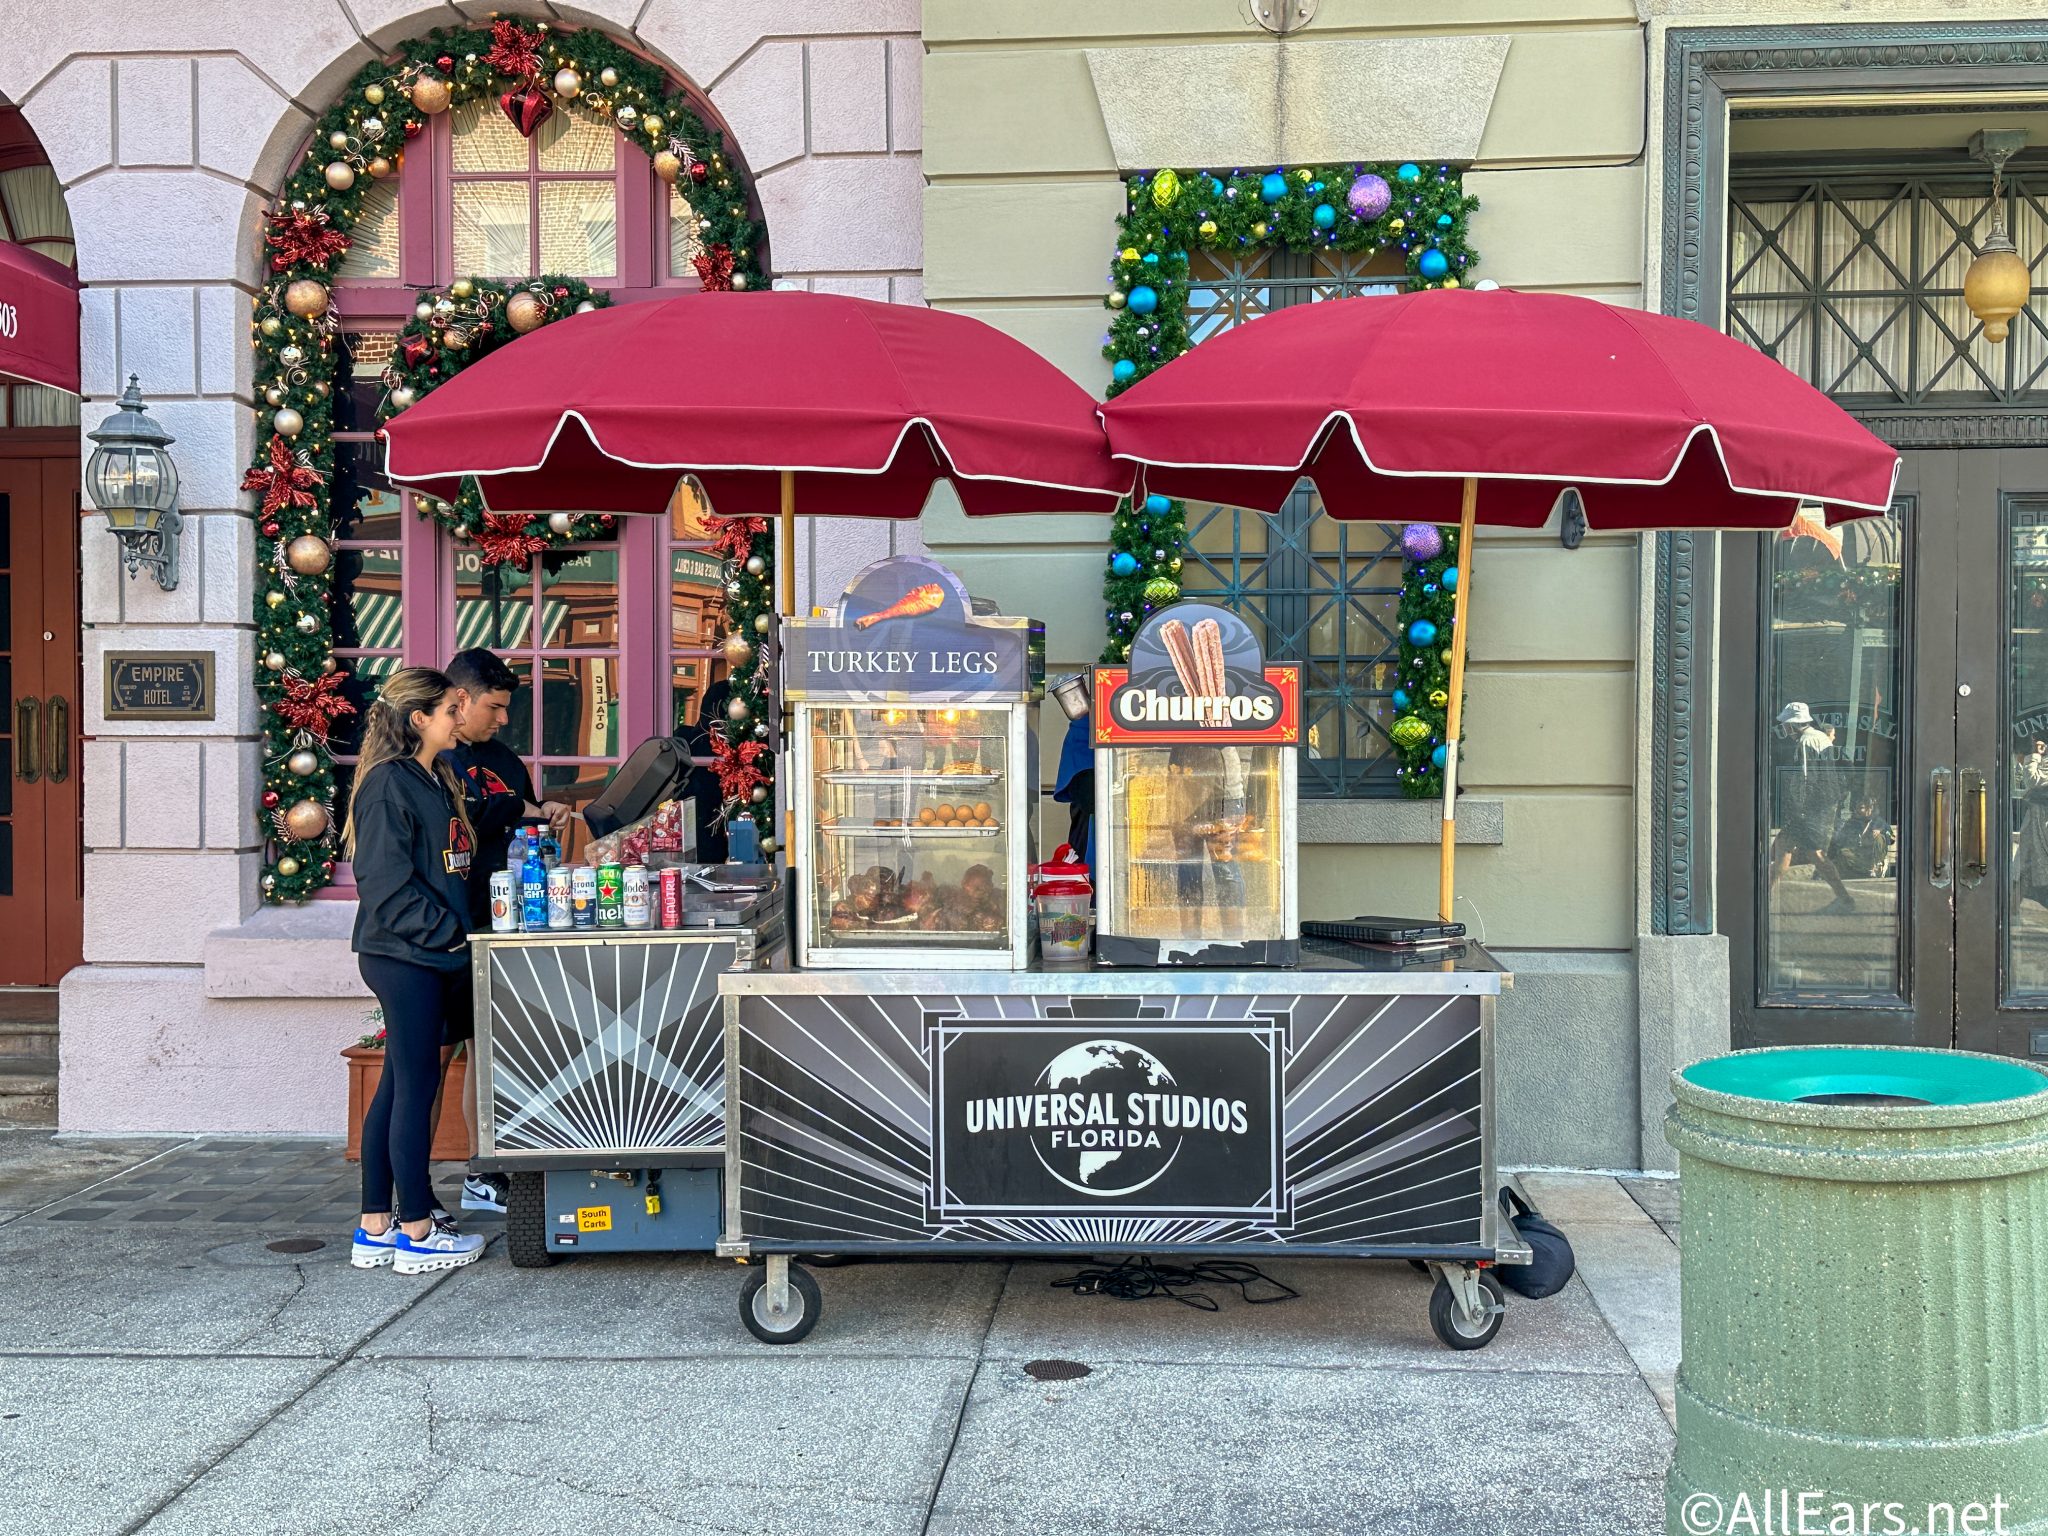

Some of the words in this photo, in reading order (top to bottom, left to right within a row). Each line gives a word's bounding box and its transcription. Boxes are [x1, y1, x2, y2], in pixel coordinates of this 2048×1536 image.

[0, 301, 18, 339] 03
[807, 650, 920, 674] TURKEY
[929, 650, 999, 675] LEGS
[131, 666, 184, 682] EMPIRE
[143, 689, 172, 705] HOTEL
[1119, 688, 1275, 722] Churros
[966, 1092, 1120, 1133] UNIVERSAL
[1127, 1092, 1248, 1135] STUDIOS
[1051, 1129, 1162, 1149] FLORIDA
[581, 1209, 607, 1218] South
[583, 1220, 606, 1229] Carts
